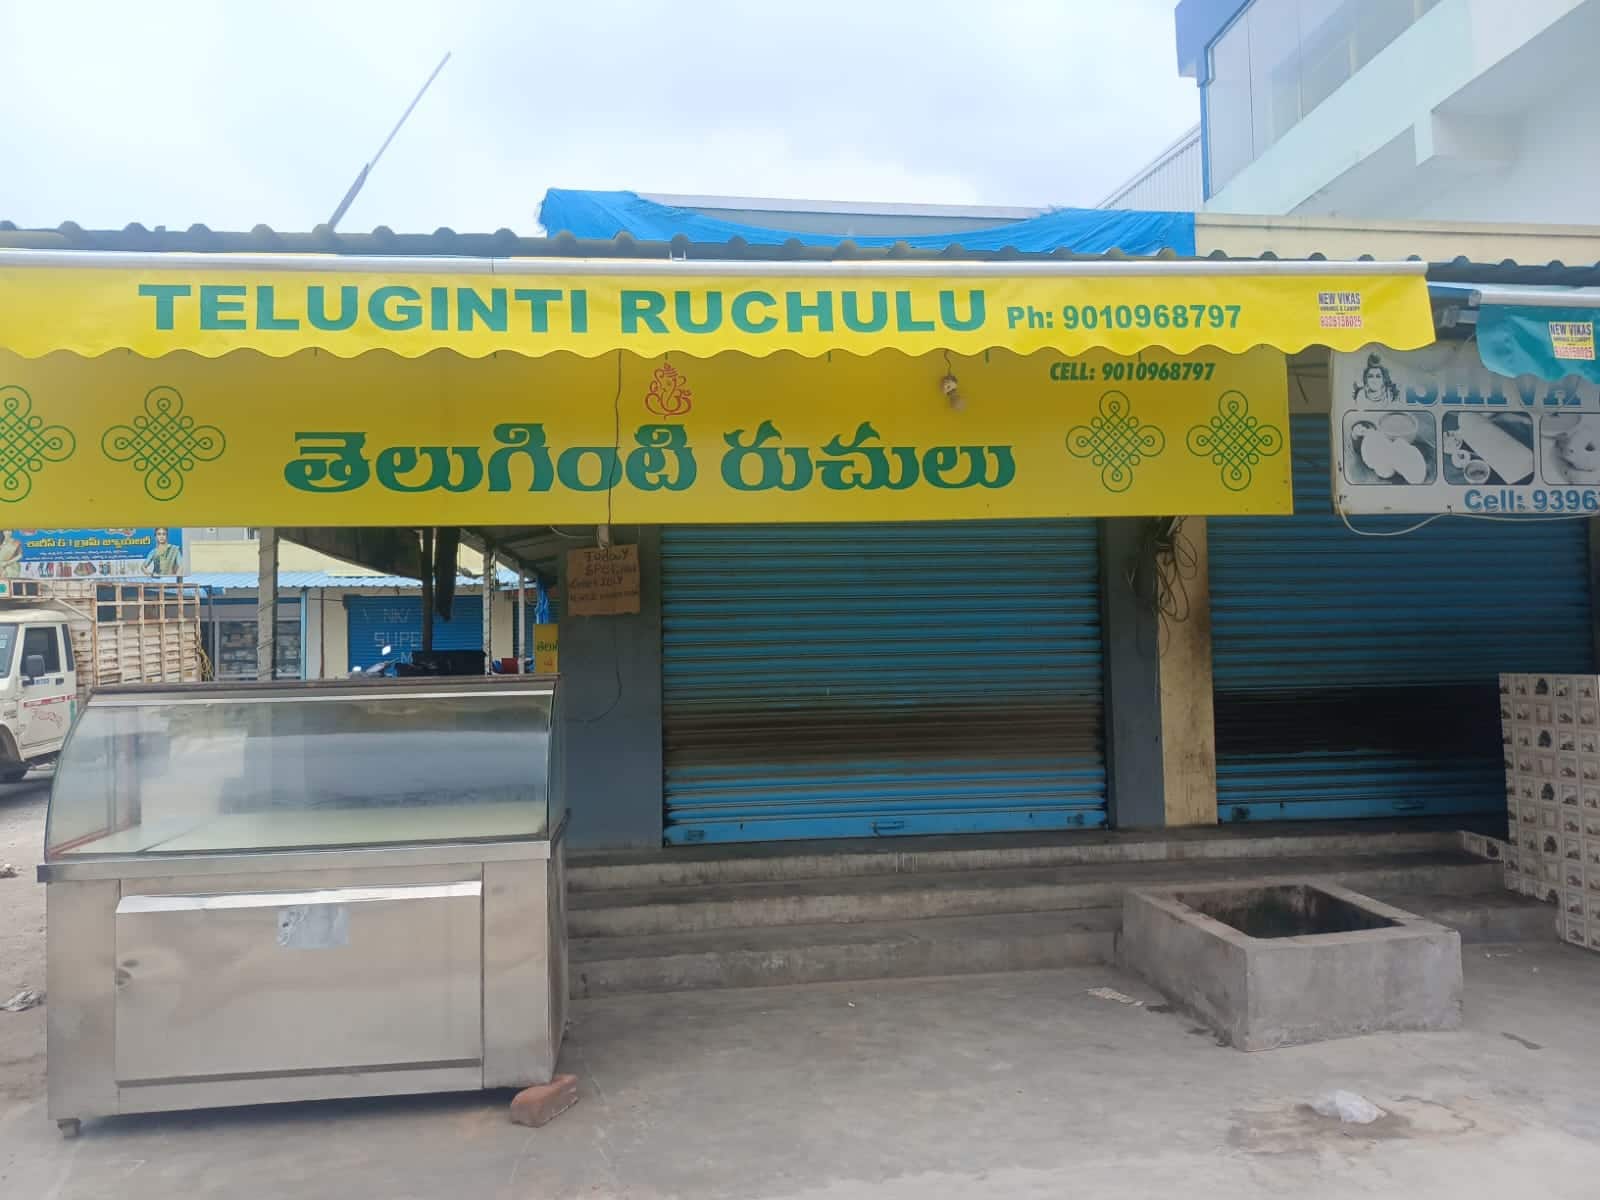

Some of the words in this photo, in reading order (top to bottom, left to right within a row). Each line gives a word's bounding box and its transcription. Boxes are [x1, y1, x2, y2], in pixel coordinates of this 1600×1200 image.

[137, 284, 589, 334] TELUGINTI
[620, 288, 987, 335] RUCHULU
[1007, 304, 1055, 331] Ph:
[1062, 303, 1243, 331] 9010968797
[1050, 362, 1096, 381] CELL:
[1102, 362, 1216, 381] 9010968797
[284, 423, 698, 494] తెలుగింటి
[721, 420, 1017, 491] రుచులు
[1464, 488, 1524, 511] Cell:
[1532, 489, 1600, 512] 9396
